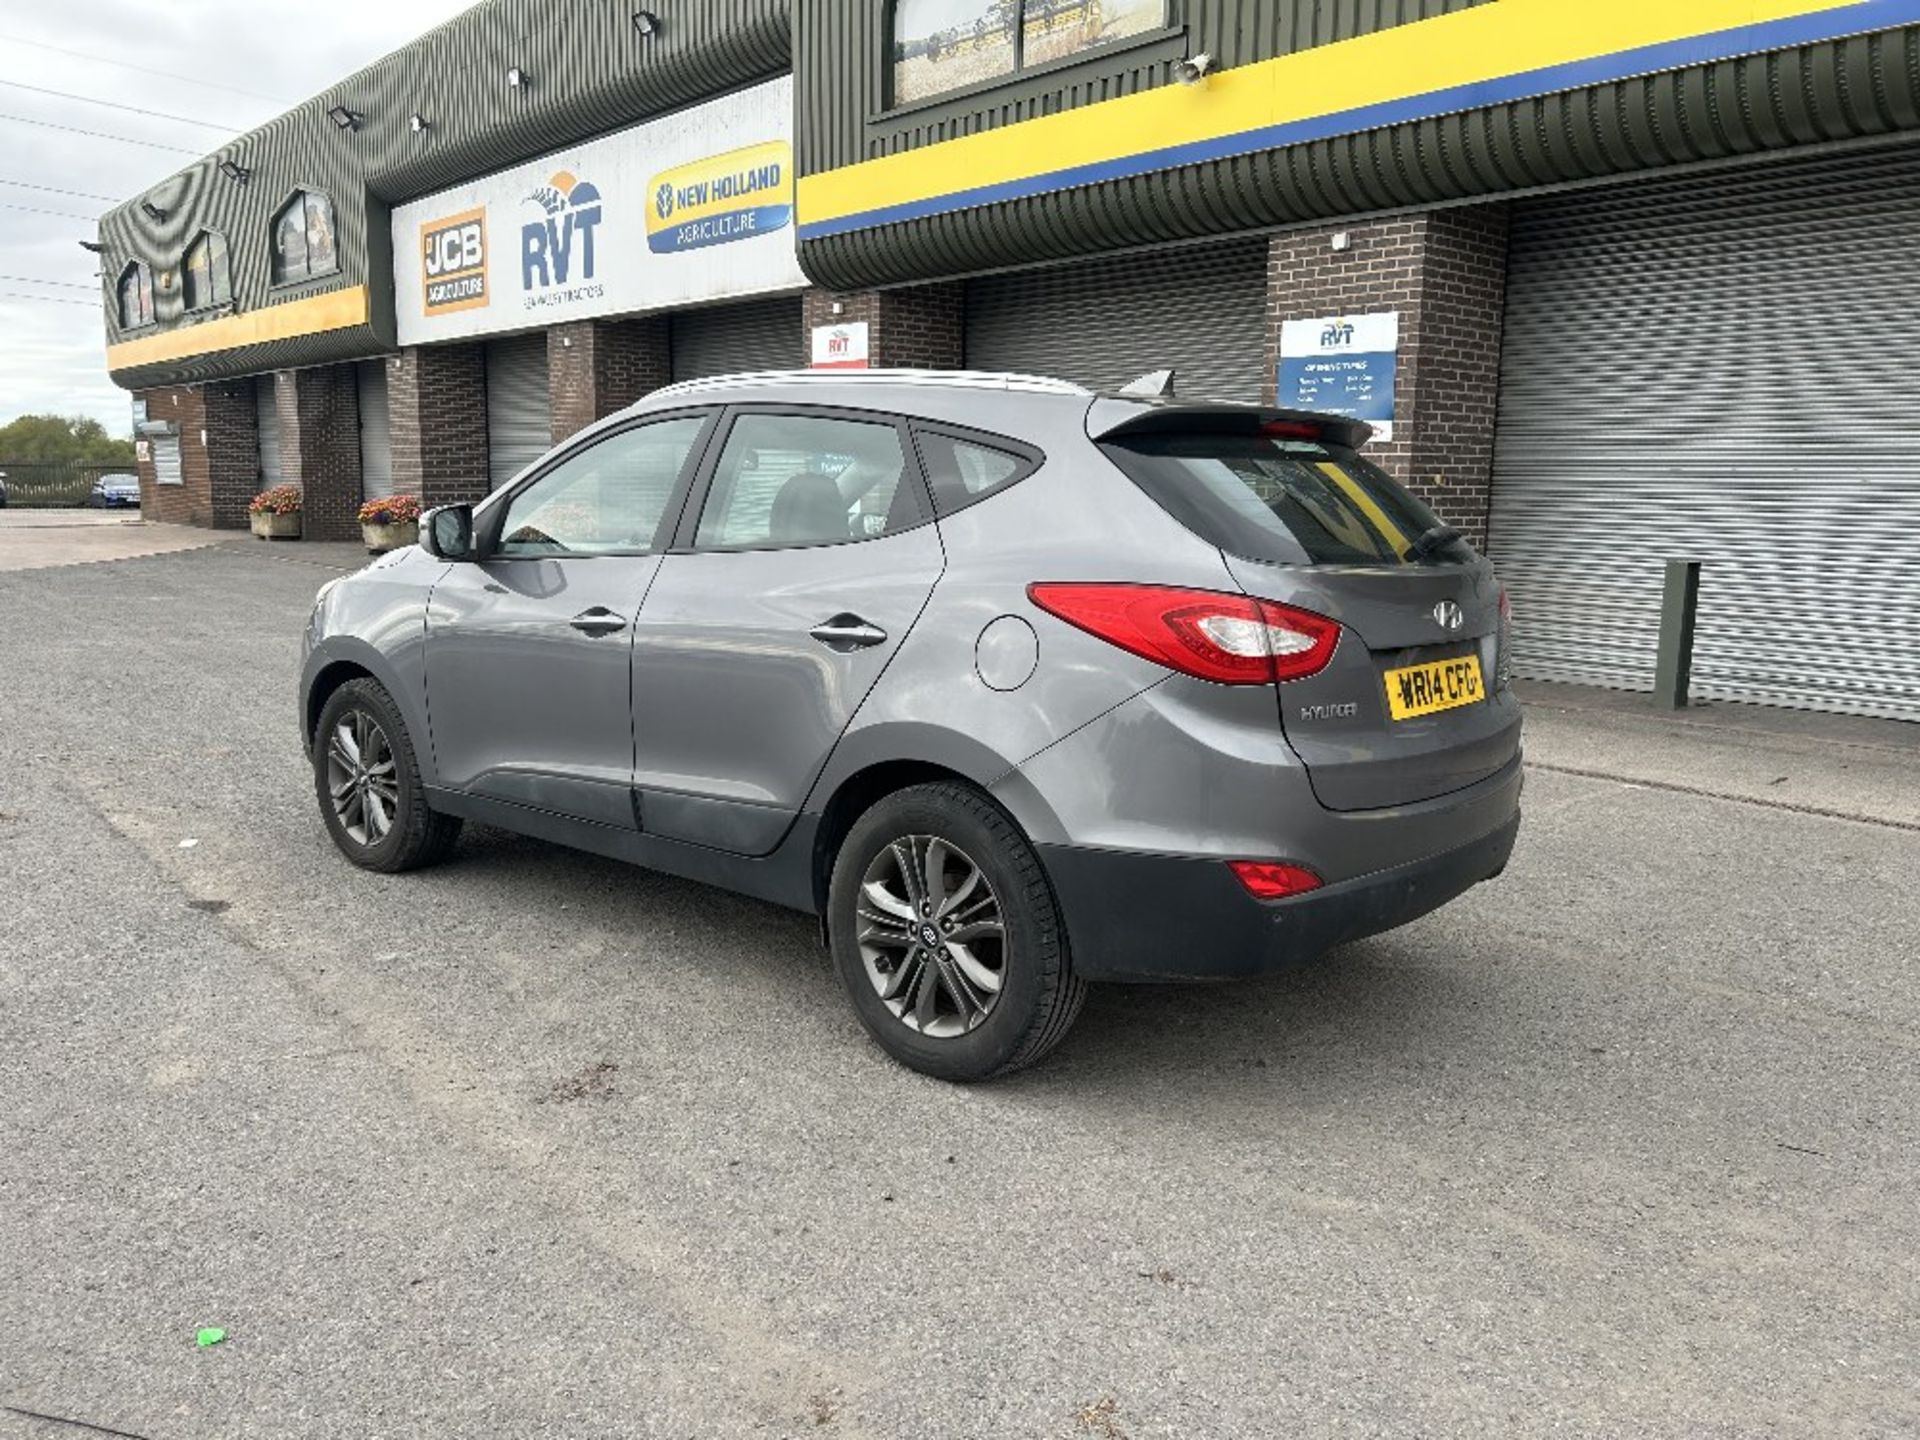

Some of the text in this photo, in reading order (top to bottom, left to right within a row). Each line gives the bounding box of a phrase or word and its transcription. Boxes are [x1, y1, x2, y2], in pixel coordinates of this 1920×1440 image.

[677, 164, 780, 209] NEW HOLLAND
[426, 224, 482, 275] JCB
[522, 205, 601, 290] RVT
[677, 212, 756, 244] AGRICULTURE
[428, 277, 482, 302] AGRICULTURE
[1320, 329, 1355, 346] RVT
[1398, 662, 1475, 709] WR14 CFG
